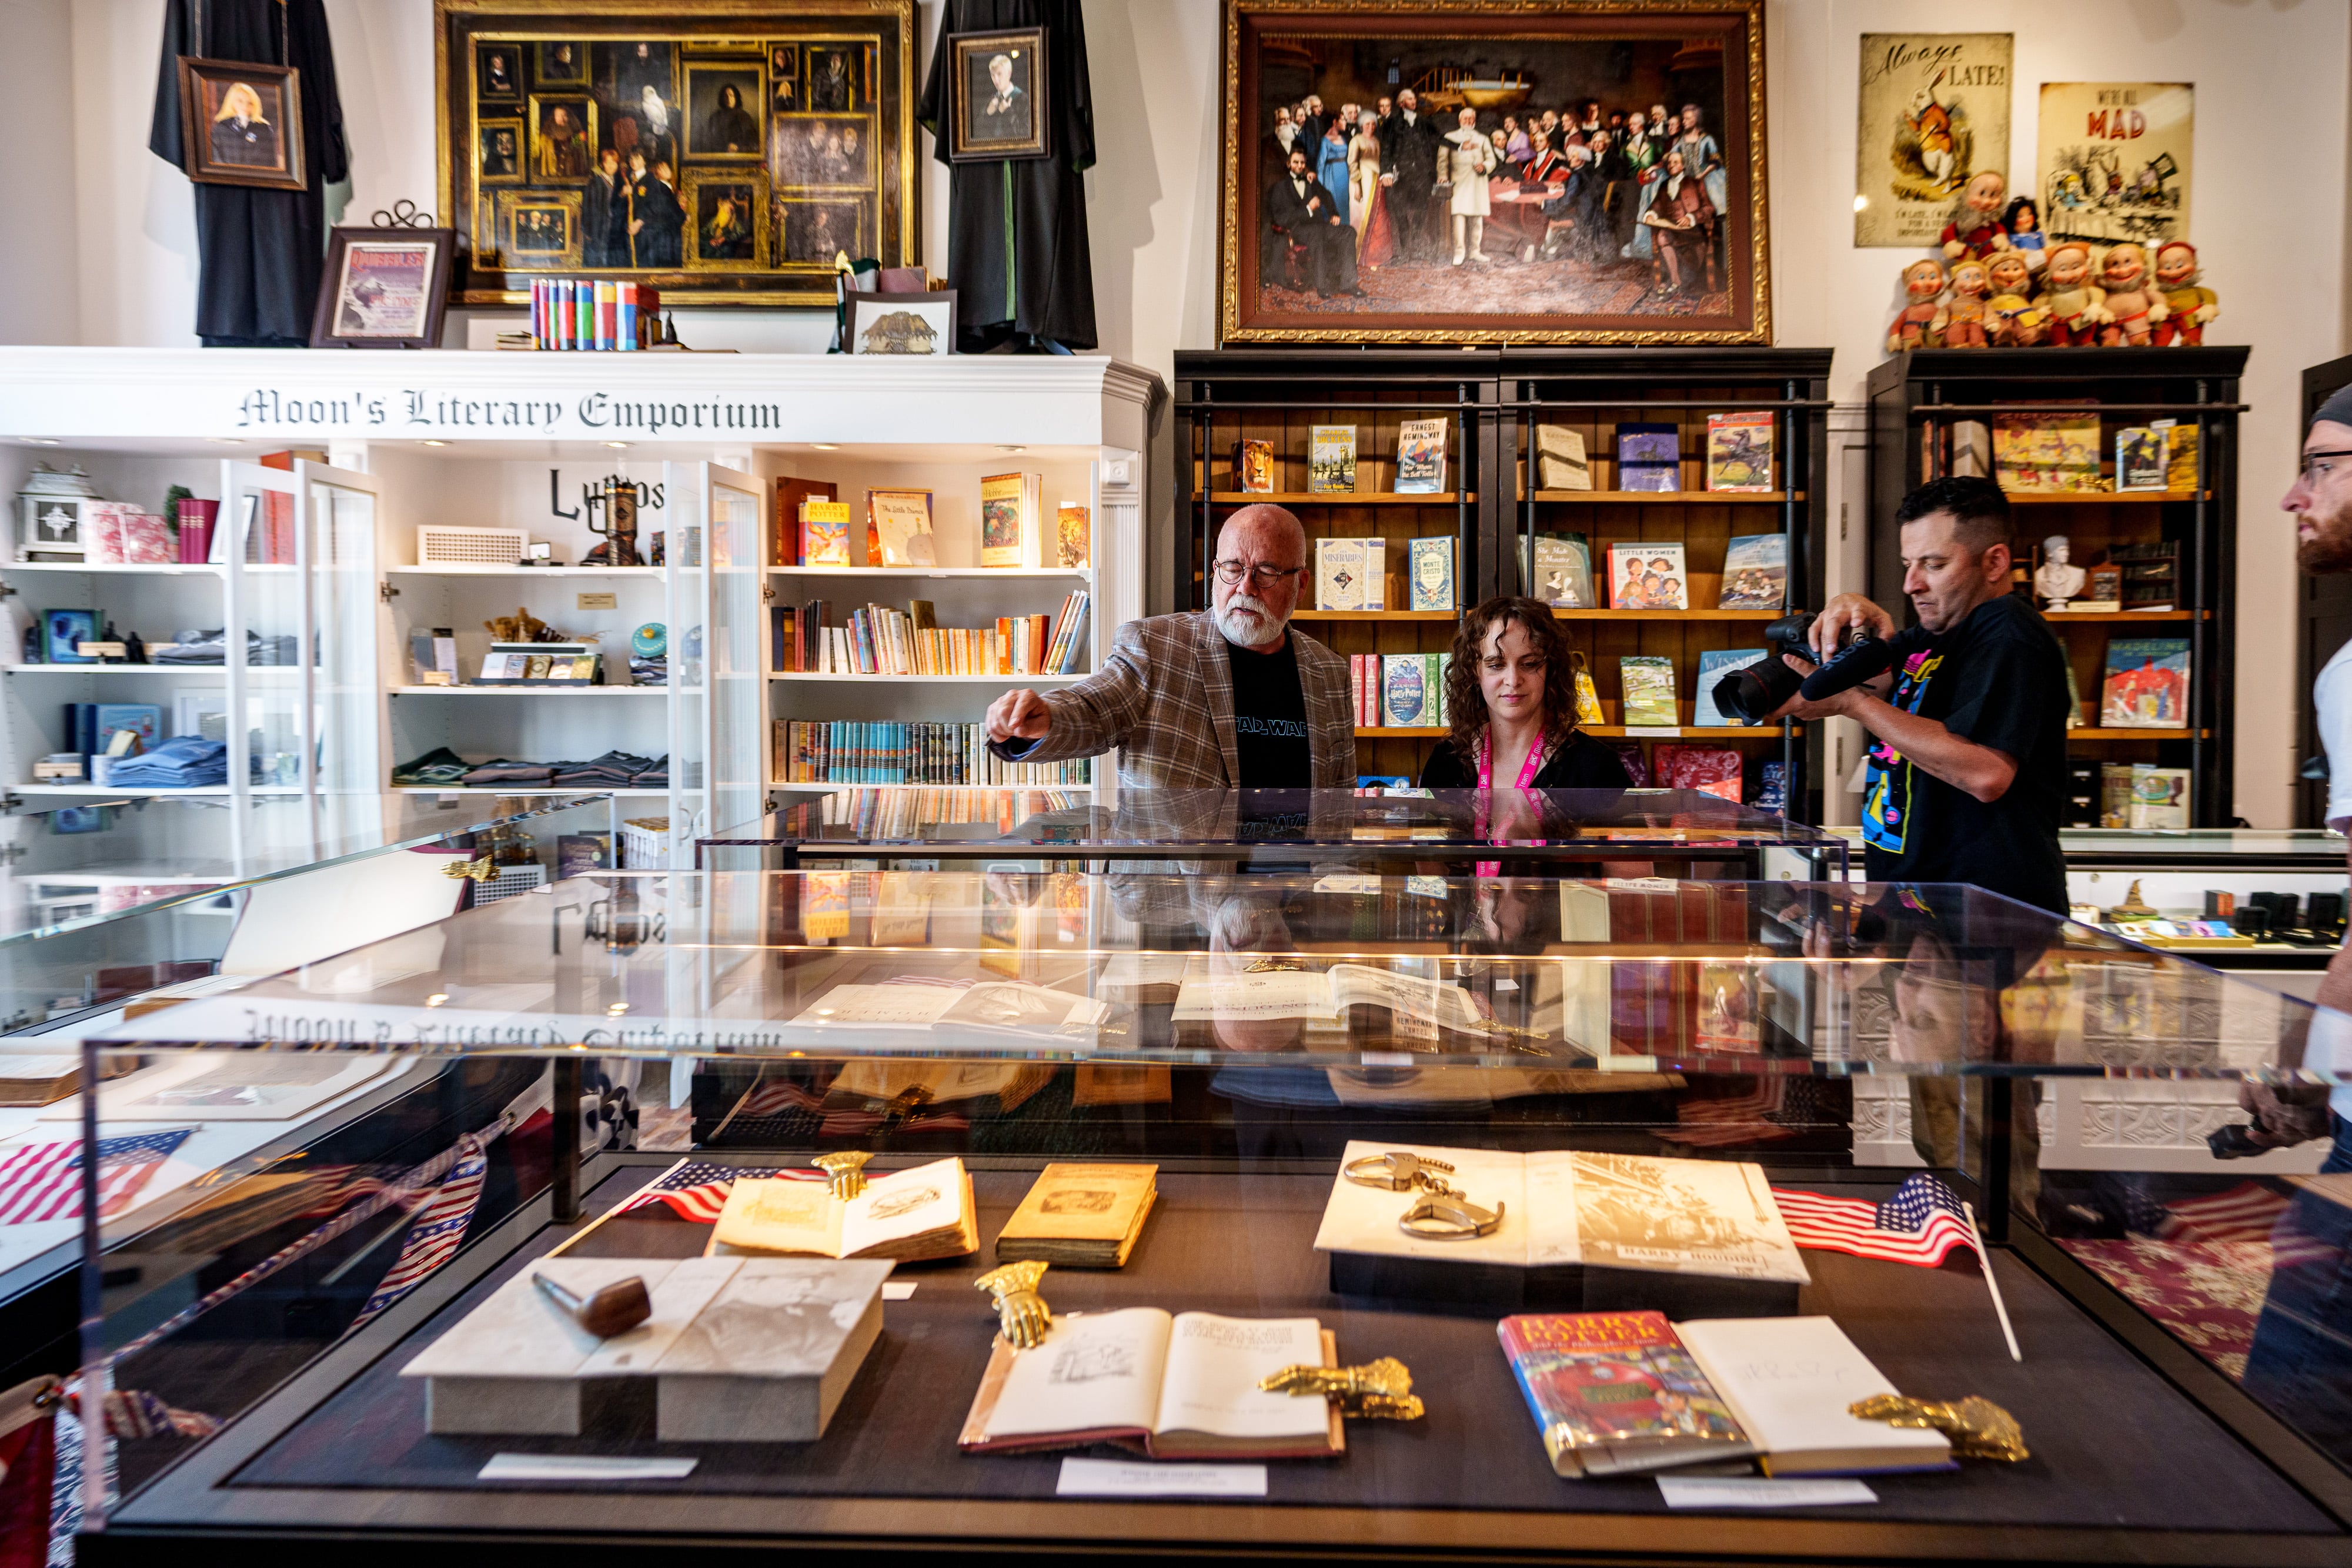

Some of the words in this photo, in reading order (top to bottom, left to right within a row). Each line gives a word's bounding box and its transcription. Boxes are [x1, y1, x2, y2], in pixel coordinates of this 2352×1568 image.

[1863, 43, 1963, 85] Always
[1949, 65, 2005, 86] LATE!
[2087, 108, 2146, 140] MAD
[238, 389, 386, 427] Moon's
[403, 389, 562, 434] Literary
[579, 392, 781, 434] Emporium
[1411, 423, 1435, 432] ERNEST
[1404, 432, 1440, 440] HEMINGWAY
[549, 469, 664, 520] Luos
[1391, 688, 1405, 700] Harry
[1405, 688, 1421, 698] Potter
[1534, 738, 1545, 754] Media
[1519, 773, 1529, 787] Team
[1521, 1315, 1645, 1331] HARRY
[1524, 1326, 1660, 1343] POTTER
